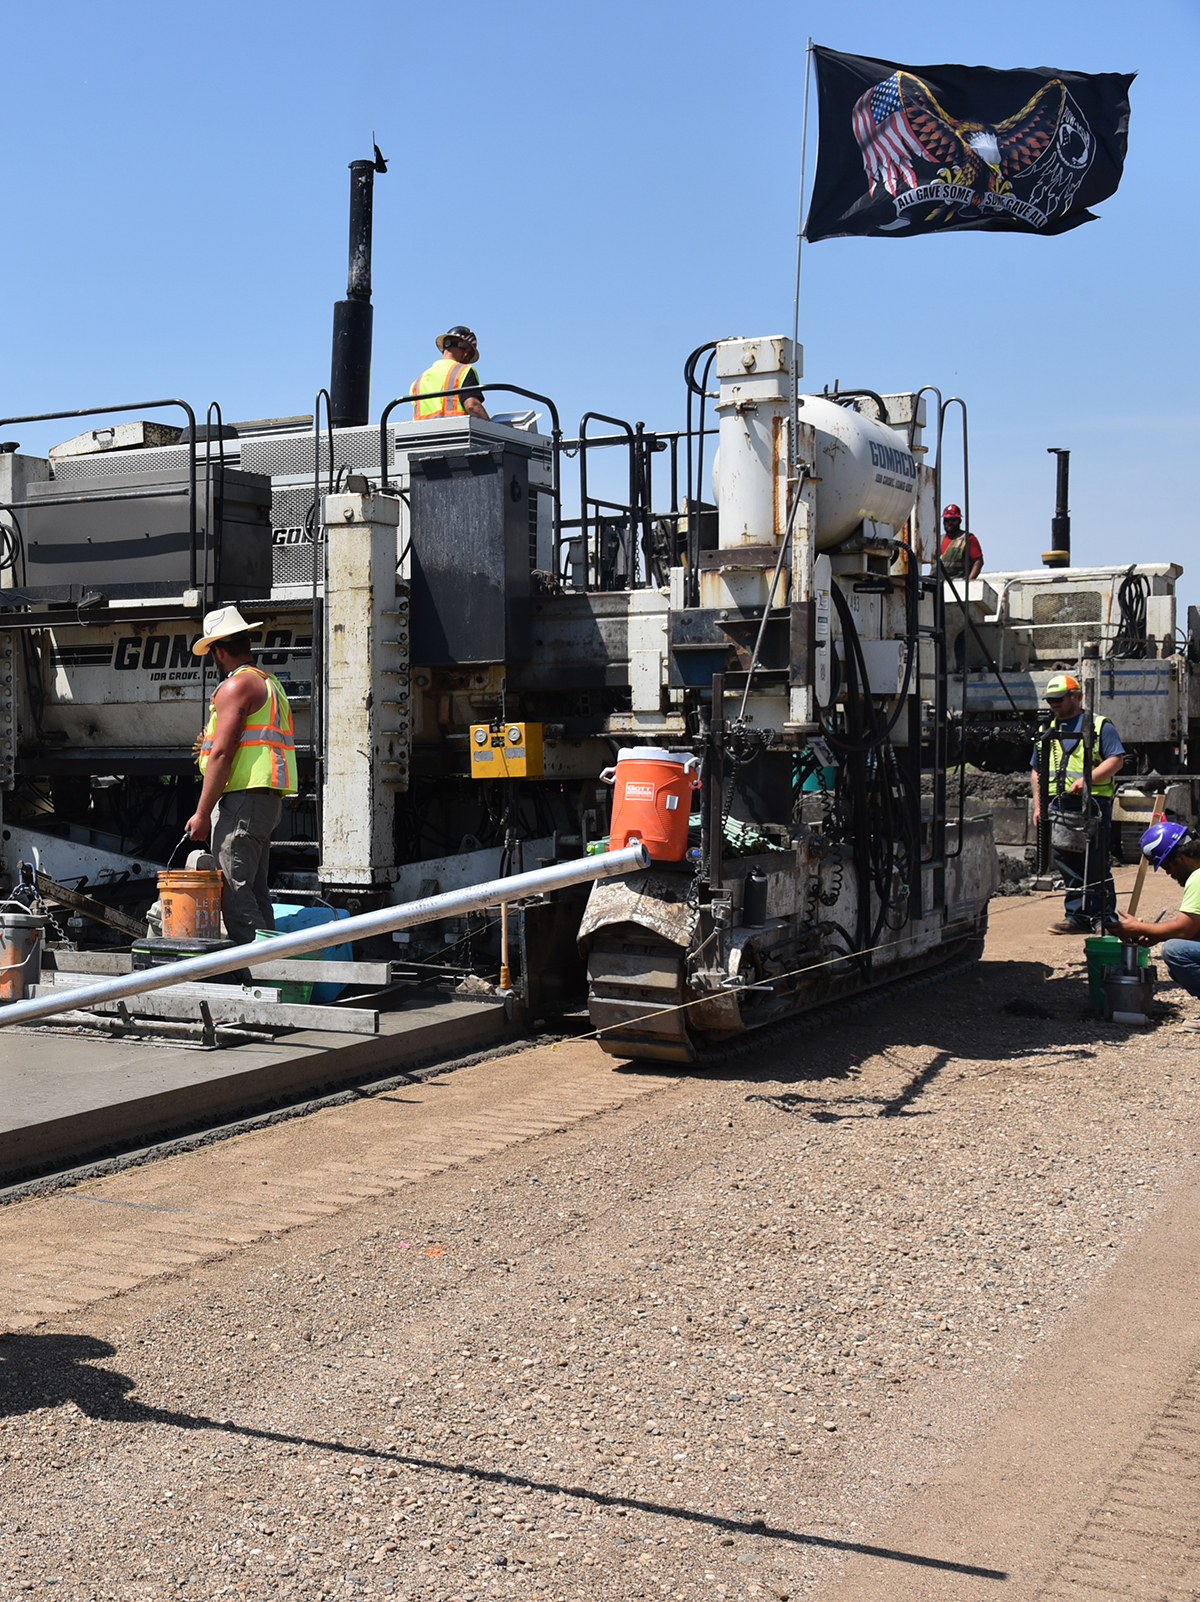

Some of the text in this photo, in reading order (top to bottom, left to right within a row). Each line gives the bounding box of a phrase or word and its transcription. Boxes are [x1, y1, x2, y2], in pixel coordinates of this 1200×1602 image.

[897, 192, 915, 209] ALL
[915, 185, 941, 200] GAVE
[942, 184, 972, 202] SOME
[1006, 198, 1032, 218] GAVE
[868, 440, 917, 480] GOMACO
[150, 672, 167, 681] IDA
[195, 909, 220, 929] DO
